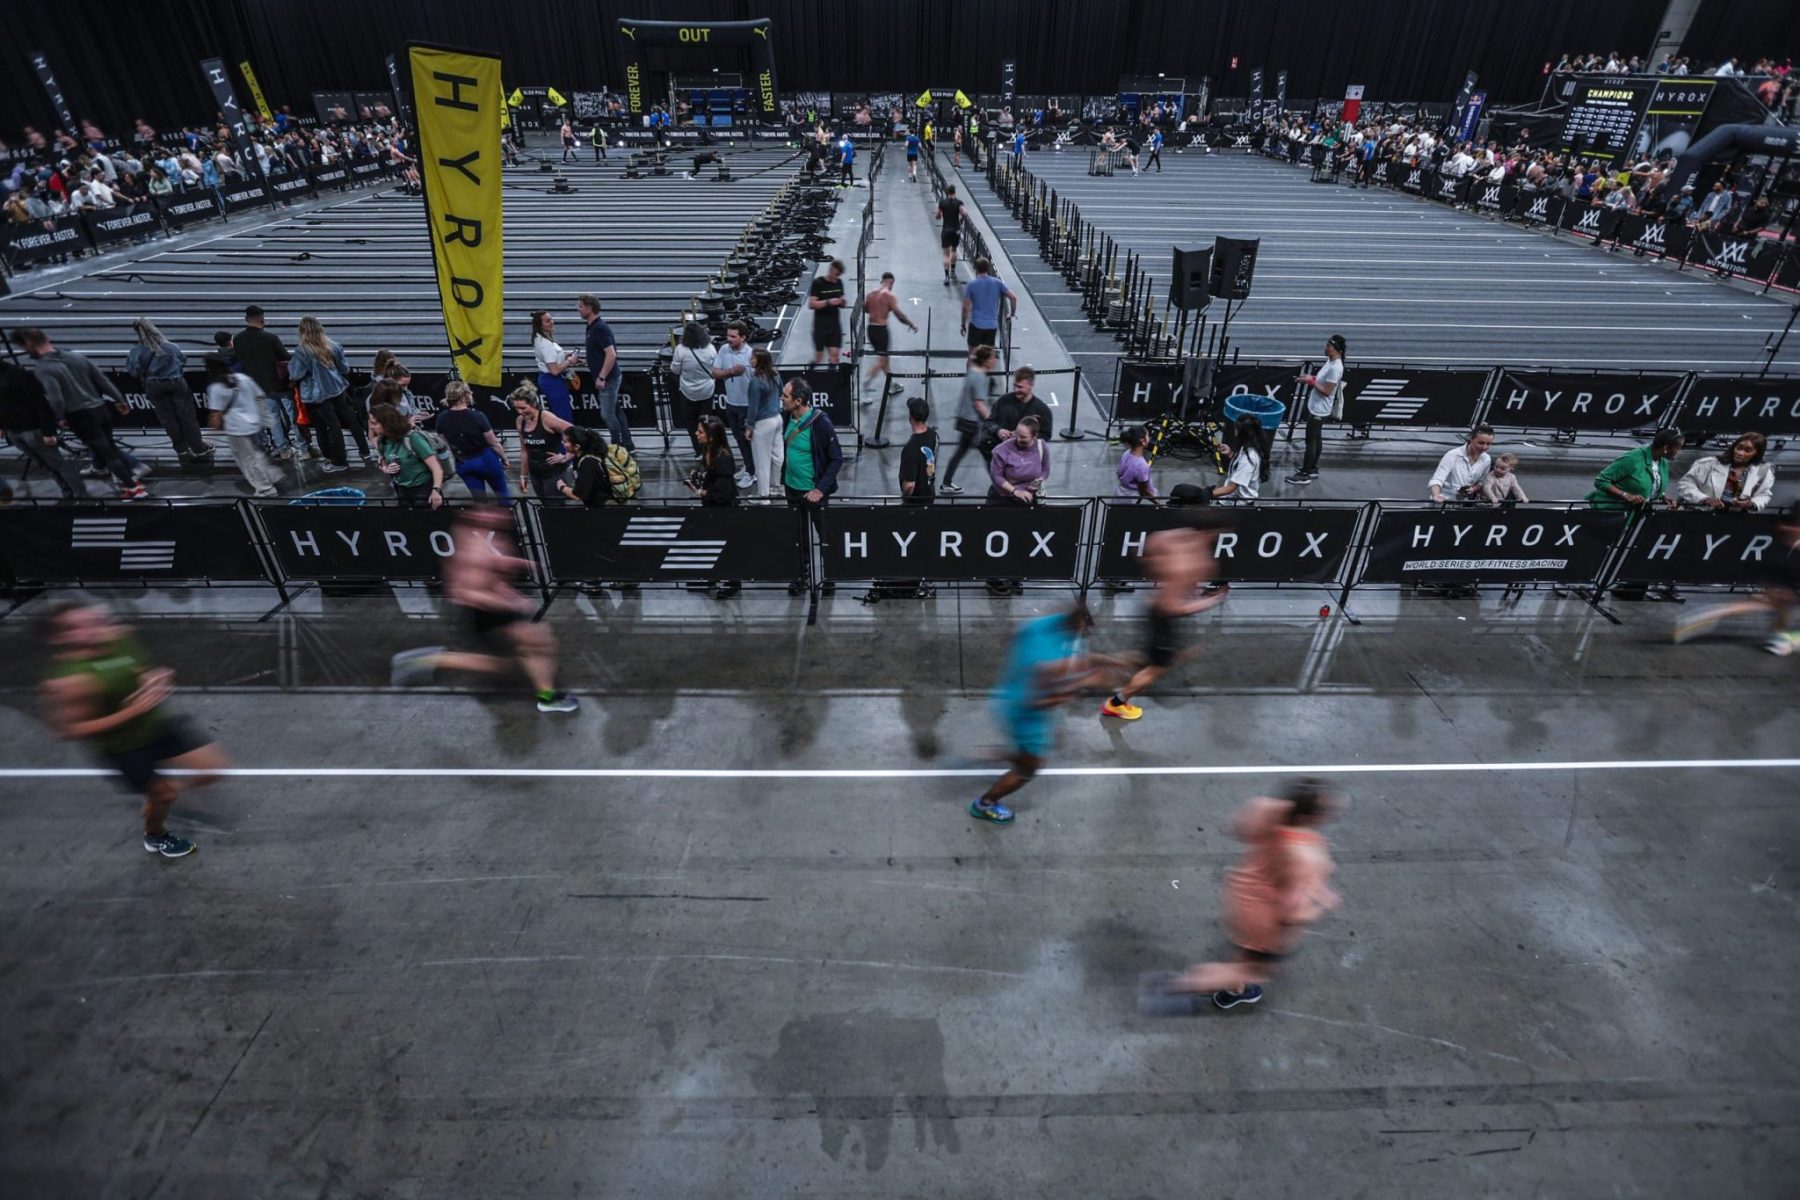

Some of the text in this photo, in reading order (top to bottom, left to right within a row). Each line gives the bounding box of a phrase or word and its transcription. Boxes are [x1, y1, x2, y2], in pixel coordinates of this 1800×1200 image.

[679, 28, 710, 42] OUT
[627, 62, 642, 113] FOREVER.
[759, 69, 775, 112] FASTER.
[1587, 89, 1634, 100] CHAMPIONS
[1655, 92, 1707, 102] HYROX
[174, 203, 195, 215] FOREVER.
[1528, 197, 1548, 213] XXL
[106, 212, 154, 231] FOREVER. FASTER.
[433, 71, 484, 366] HYROX
[1578, 209, 1601, 227] XXL
[20, 228, 79, 250] FOREVER. FASTER.
[1640, 224, 1666, 243] XXL
[1632, 239, 1667, 253] NUTRITION
[1715, 241, 1749, 263] XXL
[1706, 258, 1748, 273] NUTRITION
[1133, 382, 1282, 404] HYOX
[1506, 389, 1659, 415] HYROX
[844, 530, 1056, 558] HYROX
[1120, 531, 1329, 559] HROX
[1412, 524, 1581, 548] HYROX
[1647, 533, 1799, 561] HYR
[1405, 560, 1565, 570] WORLD SERIES OF FITNESS RACING
